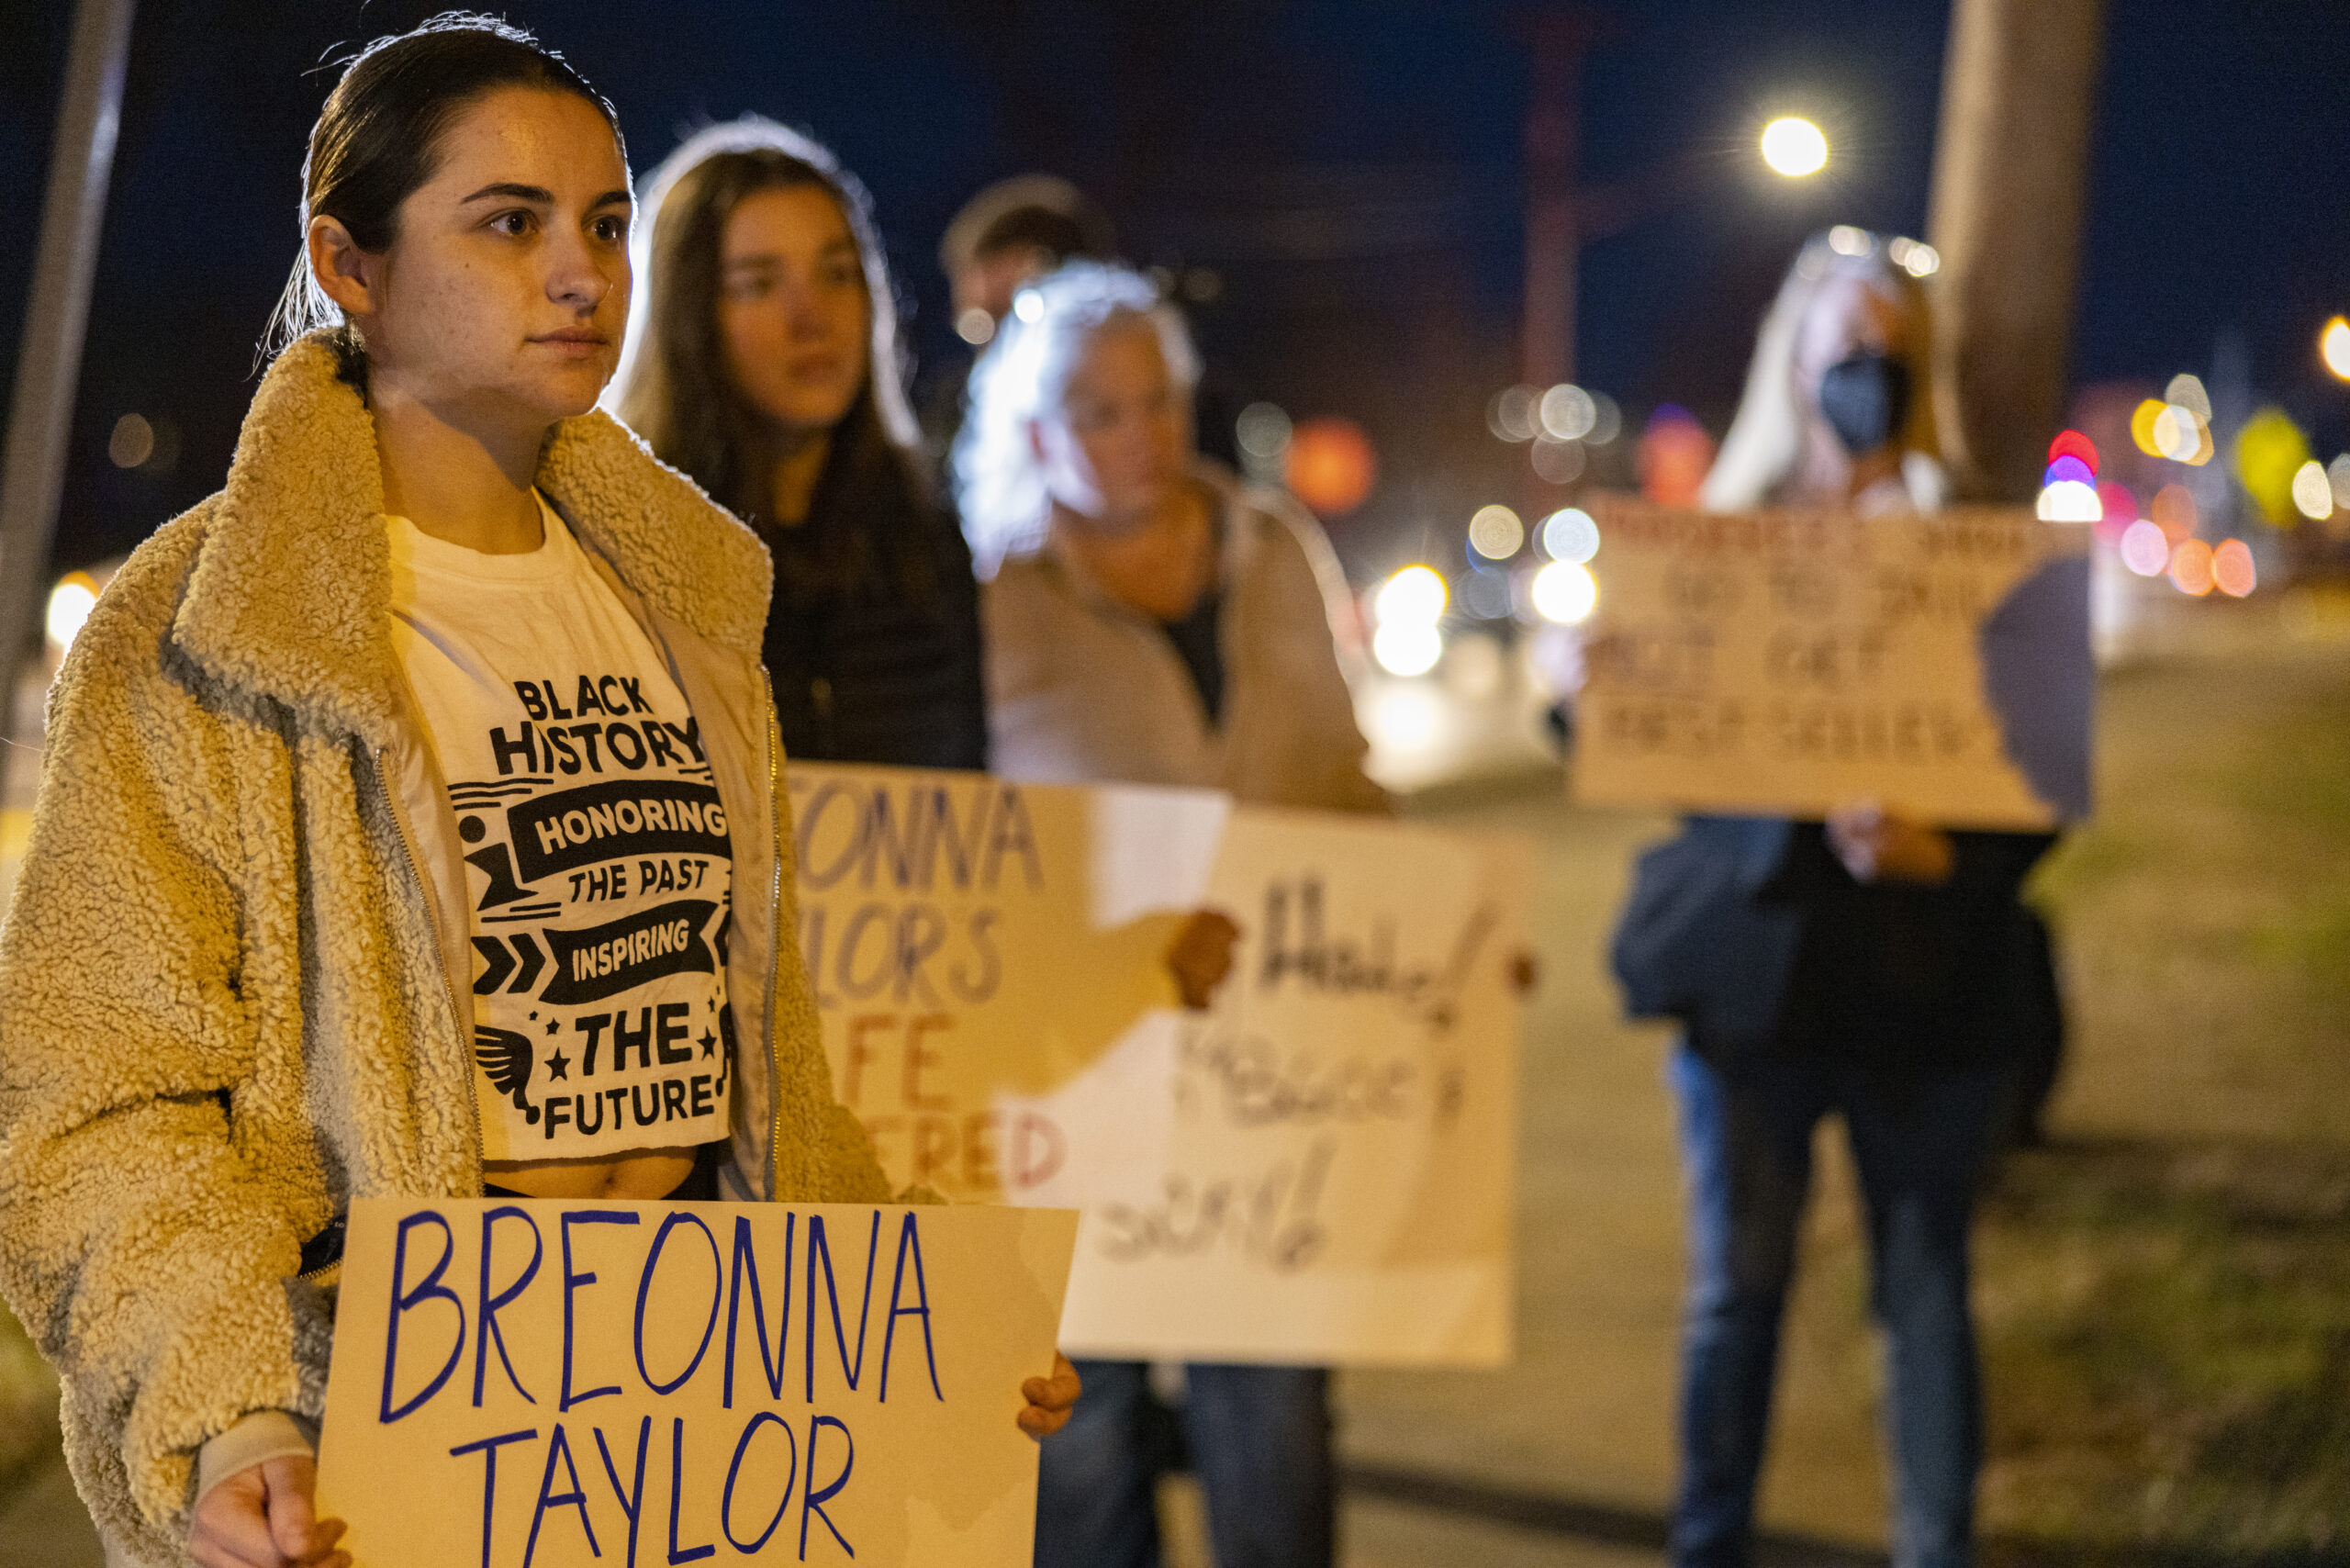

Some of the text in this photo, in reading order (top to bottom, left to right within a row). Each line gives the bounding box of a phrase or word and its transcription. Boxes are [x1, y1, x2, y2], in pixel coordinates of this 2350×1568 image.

[514, 674, 654, 722] BLACK
[489, 716, 705, 776] HISTORY
[535, 799, 729, 855] HONORING
[791, 777, 1045, 892] ONNA
[568, 859, 710, 902] THE PAST
[573, 918, 690, 982] INSPIRING
[797, 902, 1002, 1008] LORS
[575, 1002, 692, 1077] THE
[842, 1013, 960, 1113] FE
[544, 1074, 715, 1139] FUTURE
[379, 1205, 945, 1425] BREONNA
[449, 1410, 856, 1568] TAYLOR
